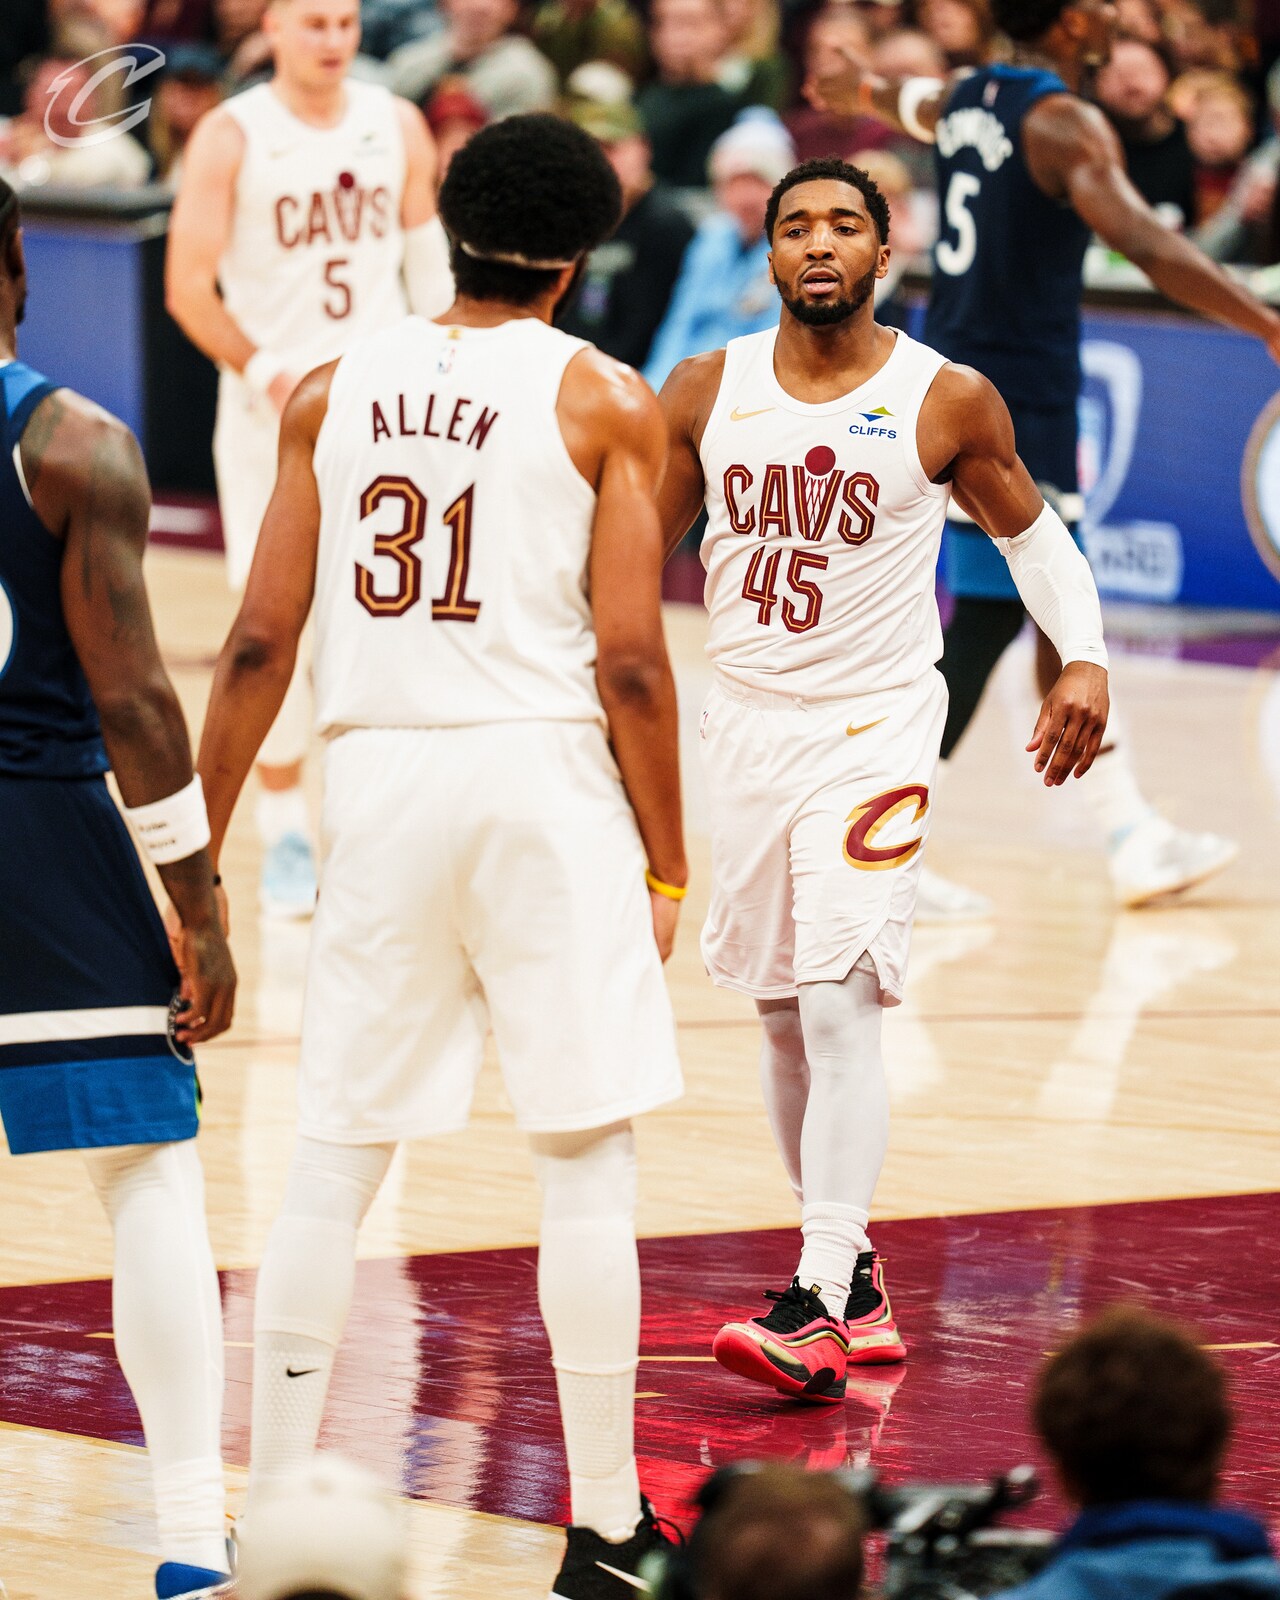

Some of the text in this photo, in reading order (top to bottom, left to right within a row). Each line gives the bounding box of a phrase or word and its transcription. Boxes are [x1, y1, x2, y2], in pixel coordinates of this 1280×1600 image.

[275, 184, 390, 250] CAVS
[935, 170, 981, 276] 5
[323, 258, 352, 320] 5
[371, 393, 499, 451] ALLEN
[848, 425, 897, 439] CLIFFS
[723, 463, 880, 546] CAVS
[355, 475, 481, 622] 31
[741, 545, 829, 634] 45
